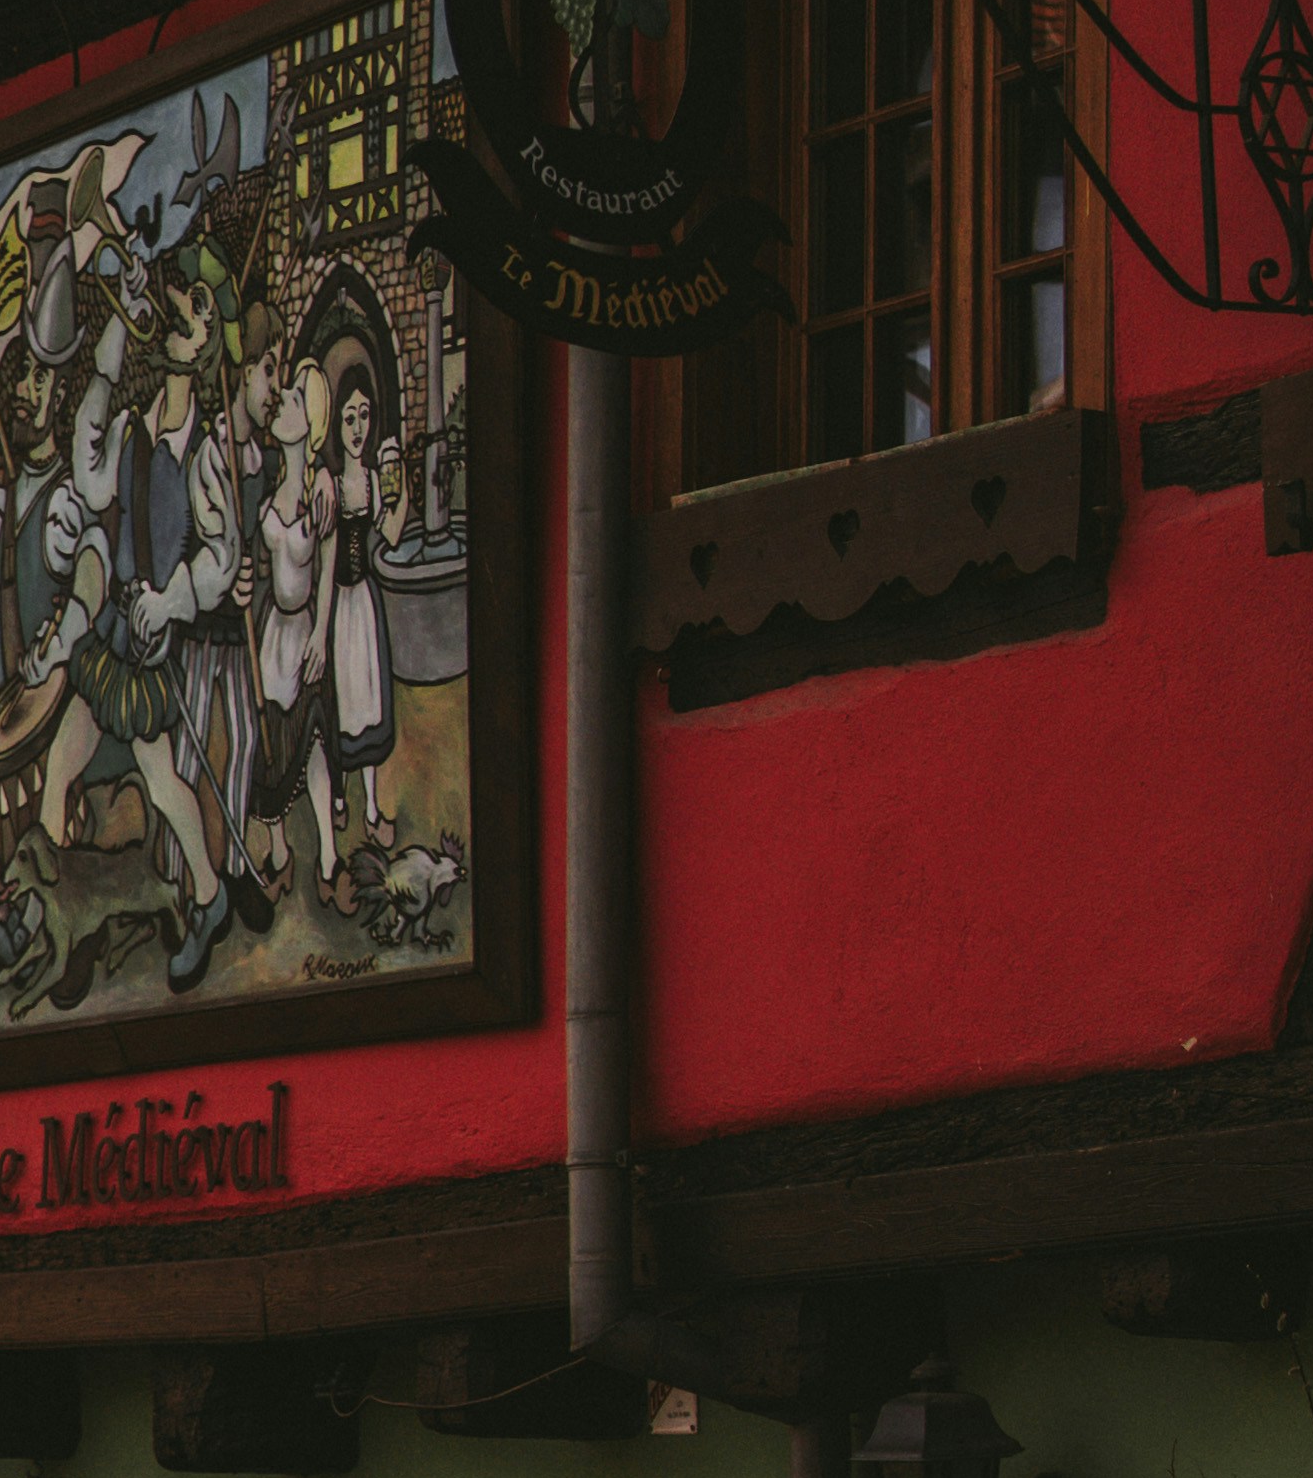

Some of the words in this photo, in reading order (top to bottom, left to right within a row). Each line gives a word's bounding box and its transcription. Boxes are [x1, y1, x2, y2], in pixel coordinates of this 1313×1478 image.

[519, 135, 684, 215] Restaurant
[501, 243, 533, 290] Le
[543, 257, 729, 329] Médiéval
[36, 1081, 291, 1208] Médiéval
